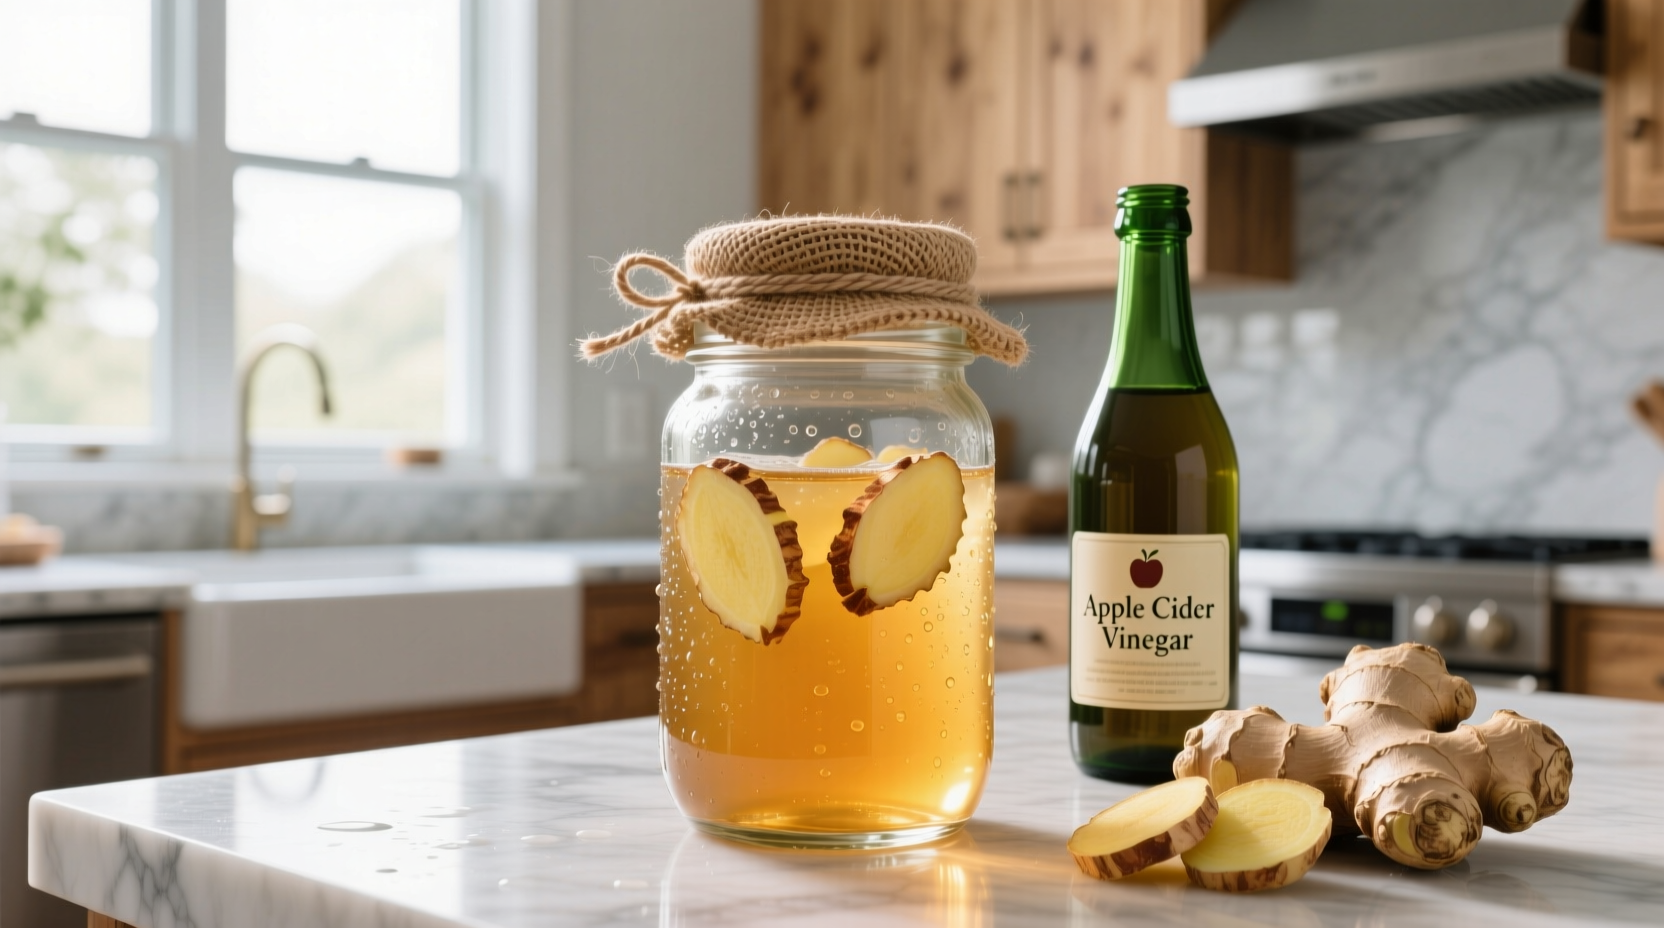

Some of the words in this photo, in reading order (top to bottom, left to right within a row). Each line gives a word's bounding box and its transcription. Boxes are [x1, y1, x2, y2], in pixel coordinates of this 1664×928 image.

[1083, 593, 1145, 624] Apple
[1151, 595, 1215, 619] Cider
[1102, 626, 1194, 657] Vinegar
